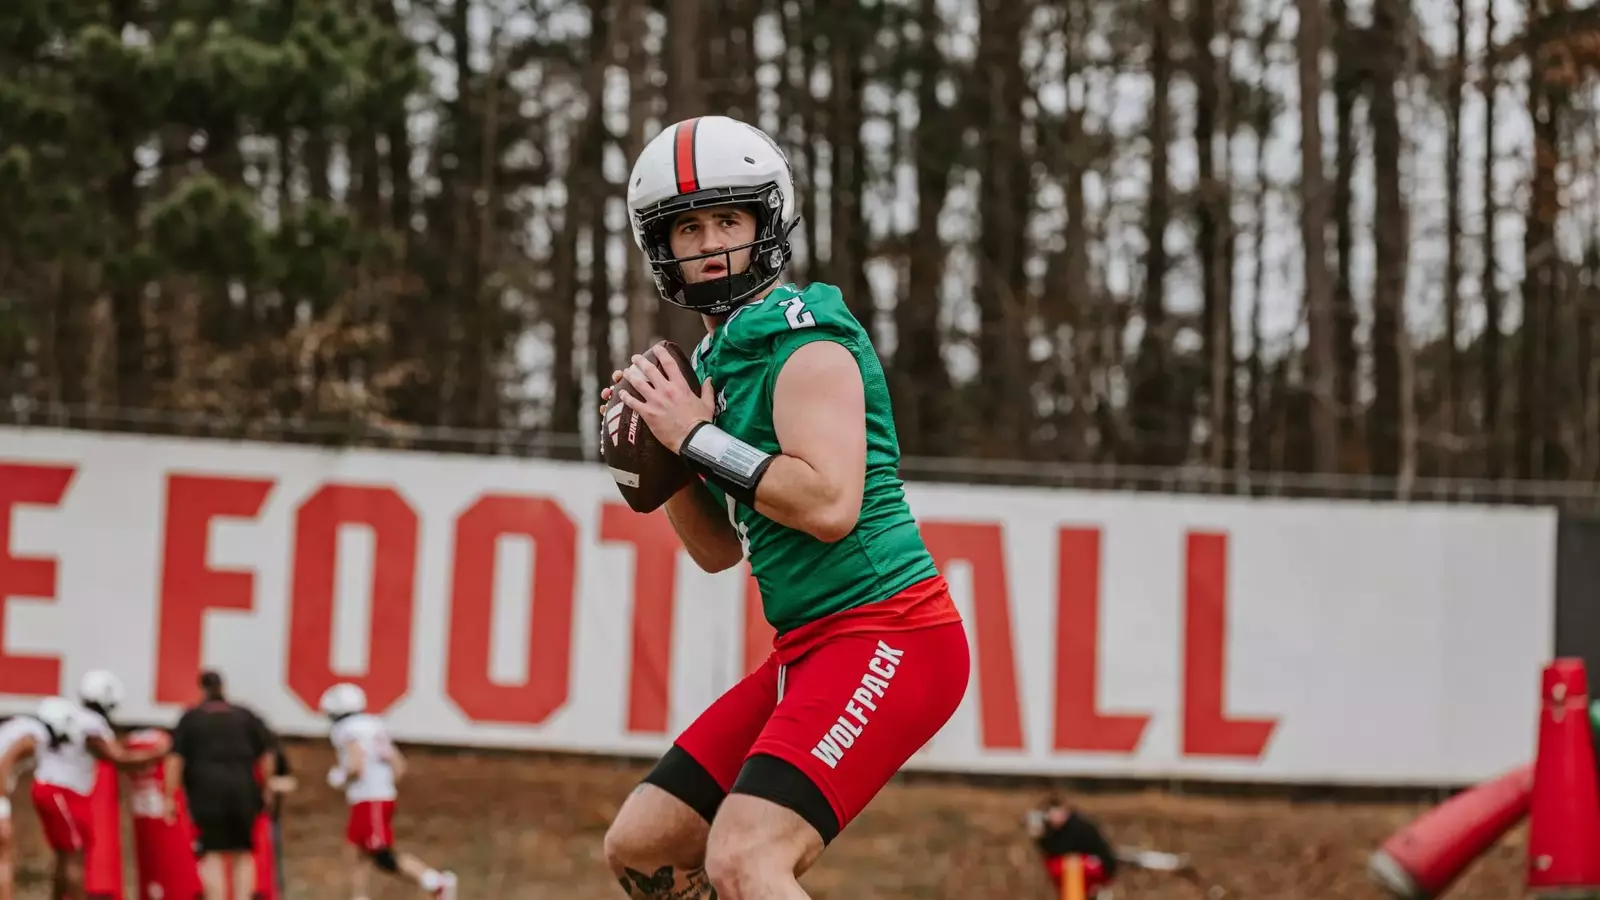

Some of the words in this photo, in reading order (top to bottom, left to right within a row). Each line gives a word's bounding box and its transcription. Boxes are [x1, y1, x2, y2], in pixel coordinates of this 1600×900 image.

[777, 295, 817, 330] 2
[627, 408, 640, 446] DIME
[155, 474, 1279, 758] FOOTALL
[810, 639, 905, 770] WOLFPACK
